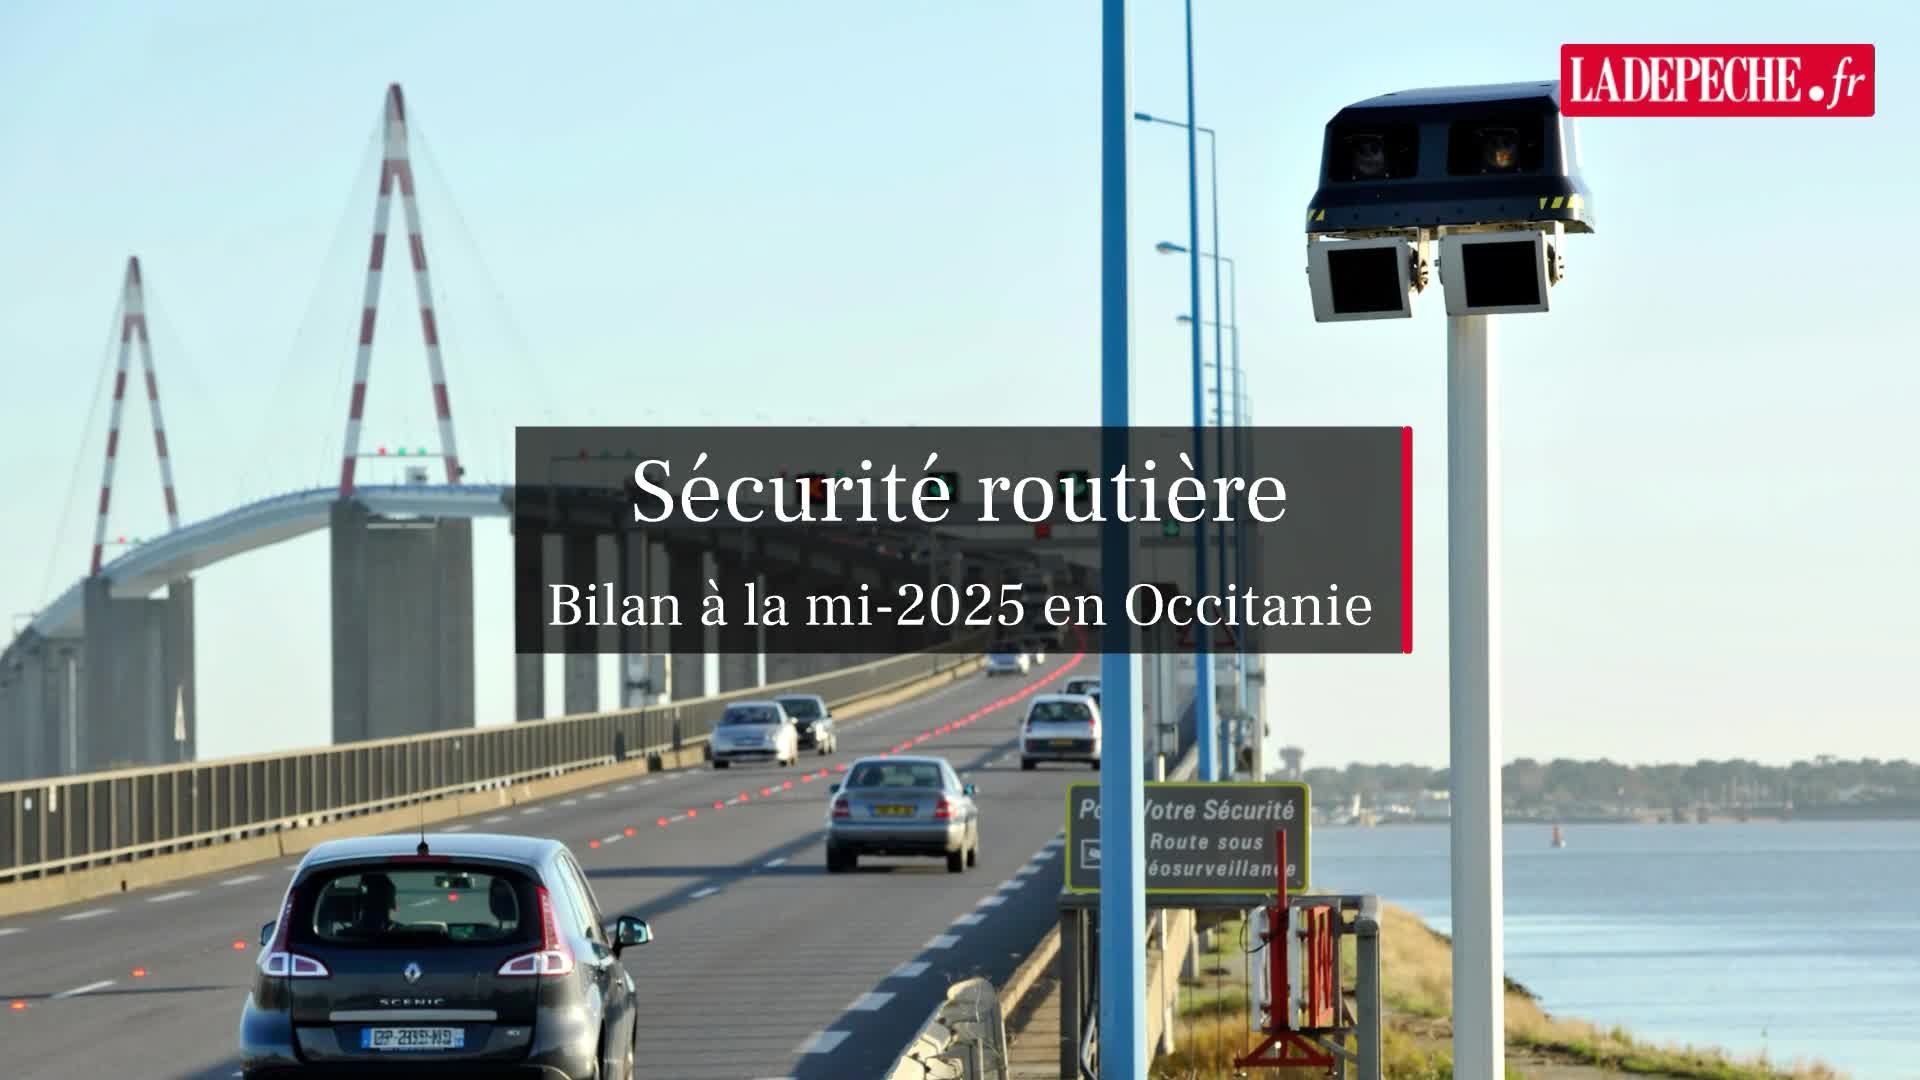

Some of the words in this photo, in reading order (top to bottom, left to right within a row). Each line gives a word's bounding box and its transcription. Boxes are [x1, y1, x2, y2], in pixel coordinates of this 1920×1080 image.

[1203, 799, 1295, 820] Sécurité
[1150, 832, 1209, 850] Route
[1217, 835, 1264, 850] sous
